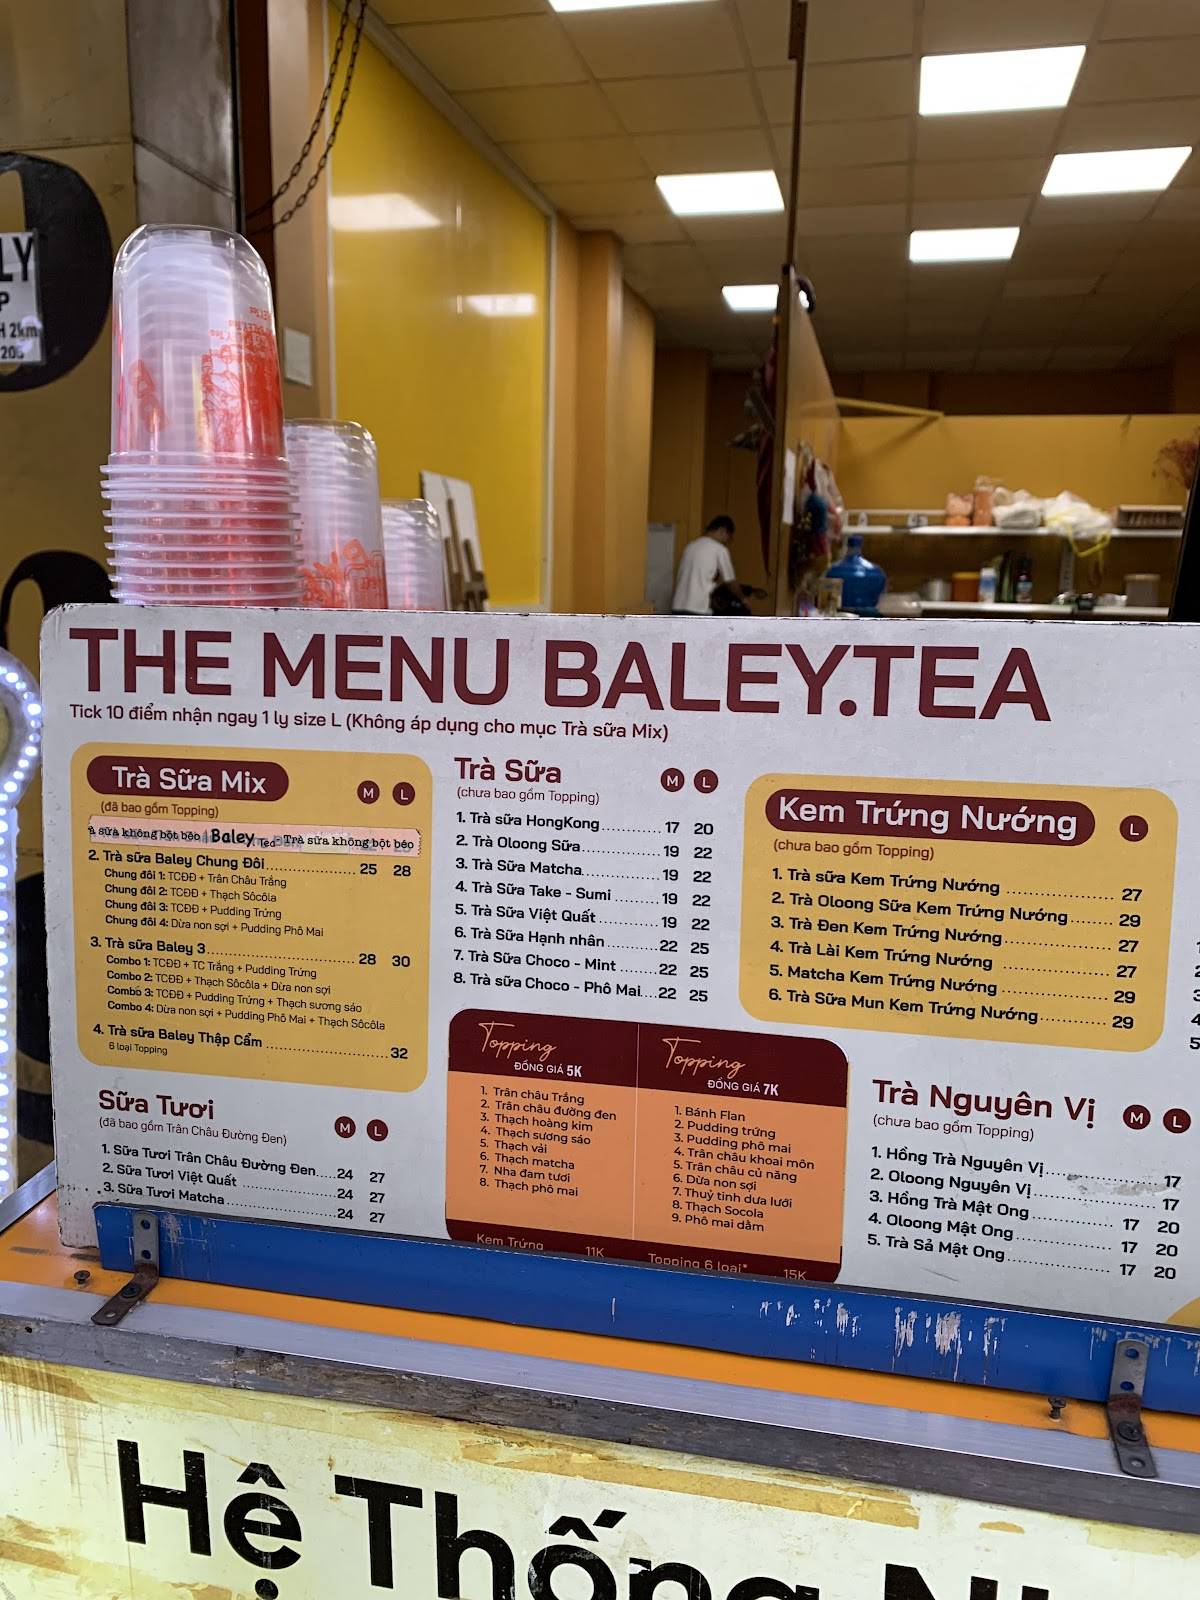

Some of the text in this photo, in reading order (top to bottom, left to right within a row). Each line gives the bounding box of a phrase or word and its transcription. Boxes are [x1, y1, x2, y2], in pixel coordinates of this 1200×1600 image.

[69, 627, 1052, 722] THE MENU BALEY.TEA
[69, 702, 668, 743] Tick 10 điểm nhận ngay 1 ly size L (Không áp dụng cho mục Trà sữa Mix)
[112, 766, 150, 789] Trà
[160, 768, 212, 791] Sữa
[222, 770, 266, 794] Mix
[454, 756, 495, 780] Trà
[505, 759, 561, 784] Sữa
[101, 801, 219, 819] (đã bao gồm Topping)
[457, 786, 599, 806] (chưa bao gồm Topping)
[456, 811, 714, 835] 1. Trà sữa HongKong 17 20
[780, 796, 844, 822] Kem
[856, 800, 949, 834] Trứng
[961, 805, 1077, 841] Nướng
[88, 849, 411, 877] 2. Trà sữa Baley Chung Đôi 25 28
[104, 868, 137, 881] Chung
[139, 870, 156, 880] đôi
[158, 871, 166, 880] 1:
[168, 871, 197, 882] TCĐĐ
[207, 873, 229, 884] Trân
[231, 874, 257, 885] Châu
[259, 875, 287, 889] Trắng
[772, 868, 1142, 902] 1. Trà sữa Kem Trứng Nướng 27
[455, 881, 467, 892] 4.
[471, 881, 492, 894] Trà
[497, 882, 525, 896] Sữa
[529, 884, 561, 898] Take
[576, 887, 611, 901] Sumi
[662, 893, 678, 905] 19
[692, 894, 711, 907] 22
[90, 936, 410, 967] 3. Trà sữa Baley 3 28 30
[93, 1023, 408, 1059] 4. Trà sữa Baley Thập Cẩm 32
[478, 1021, 557, 1062] Topping
[514, 1059, 582, 1077] ĐỒNG GIÁ 5K
[662, 1037, 746, 1079] Topping
[480, 1086, 584, 1106] 1. Trân châu Trắng
[707, 1078, 779, 1096] ĐỒNG GIÁ 7K
[99, 1089, 148, 1113] Sữa
[156, 1094, 214, 1120] Tươi
[674, 1105, 745, 1122] 1. Bánh Flan
[872, 1079, 918, 1106] Trà
[930, 1084, 1052, 1120] Nguyên
[1064, 1096, 1095, 1129] Vị
[101, 1143, 385, 1183] 1. Sữa Tươi Trân Châu Đường Đen 24 27
[872, 1146, 1181, 1188] 1. Hồng Trà Nguyên Vị 17
[476, 1233, 503, 1247] Kem
[117, 1439, 302, 1600] Hệ
